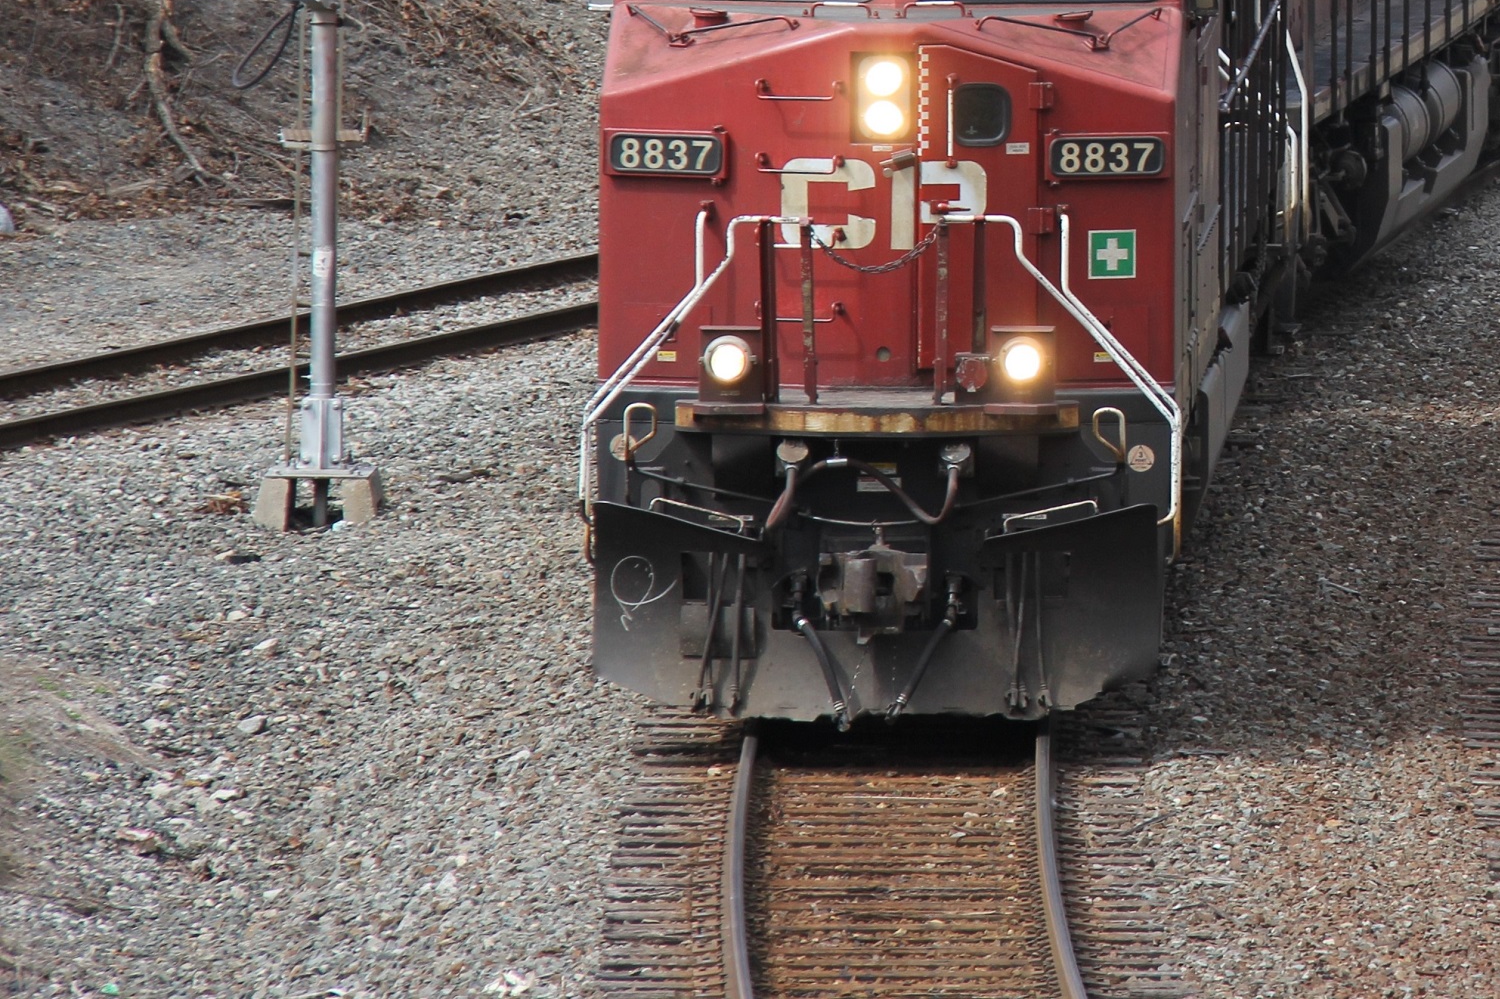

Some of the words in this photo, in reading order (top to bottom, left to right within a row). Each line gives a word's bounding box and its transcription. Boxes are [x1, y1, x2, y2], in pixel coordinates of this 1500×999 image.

[620, 138, 713, 170] 8837
[1060, 142, 1155, 173] 8837
[781, 158, 987, 250] CP
